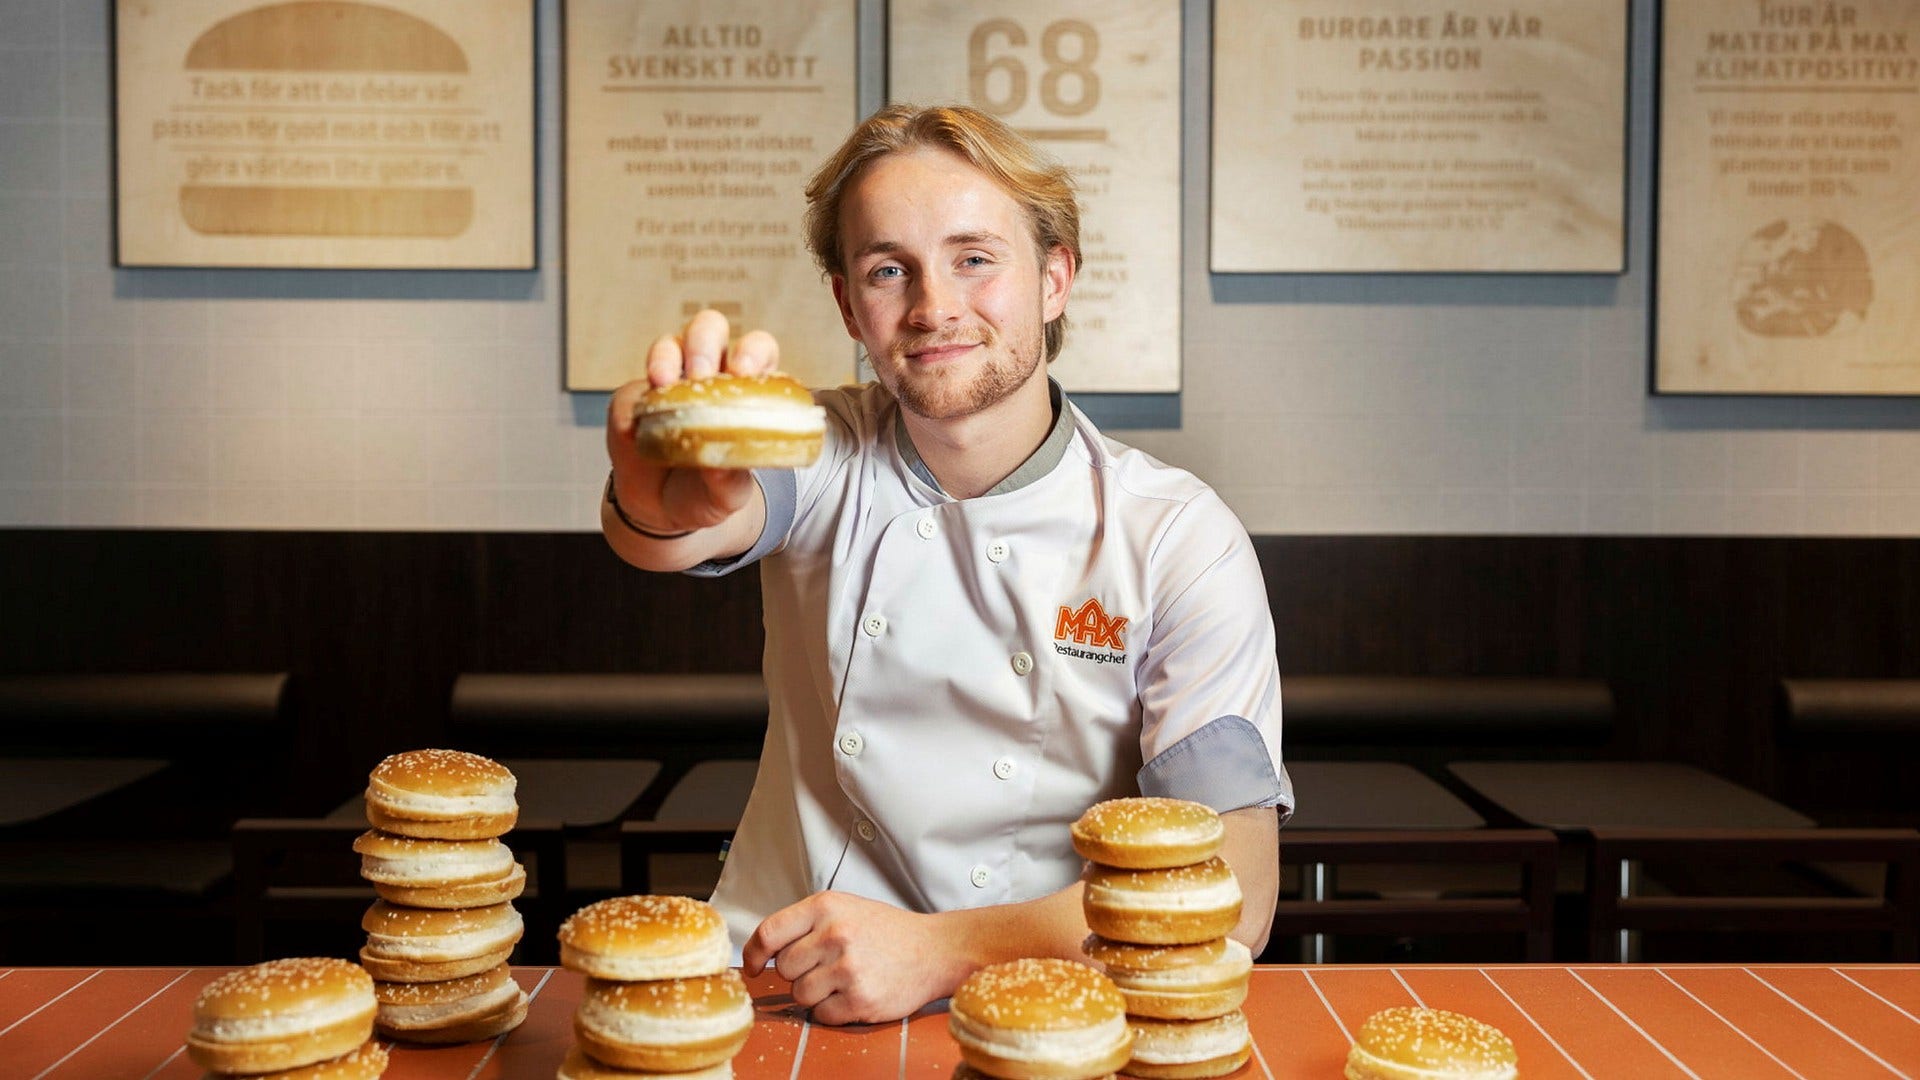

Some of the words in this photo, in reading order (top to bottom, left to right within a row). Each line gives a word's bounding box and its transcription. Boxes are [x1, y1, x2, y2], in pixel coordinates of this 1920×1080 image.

[663, 24, 762, 48] ALLTID
[1298, 16, 1431, 39] BURGARE
[1487, 9, 1543, 39] VÅR
[1707, 32, 1798, 52] MATEN
[1851, 32, 1909, 52] MAX
[607, 55, 735, 79] SVENSKT
[746, 50, 818, 79] KÖTT
[968, 17, 1101, 118] 68
[1358, 47, 1482, 71] PASSION
[1696, 58, 1919, 79] KLIMATPOSITIV?
[1054, 597, 1129, 651] MAX
